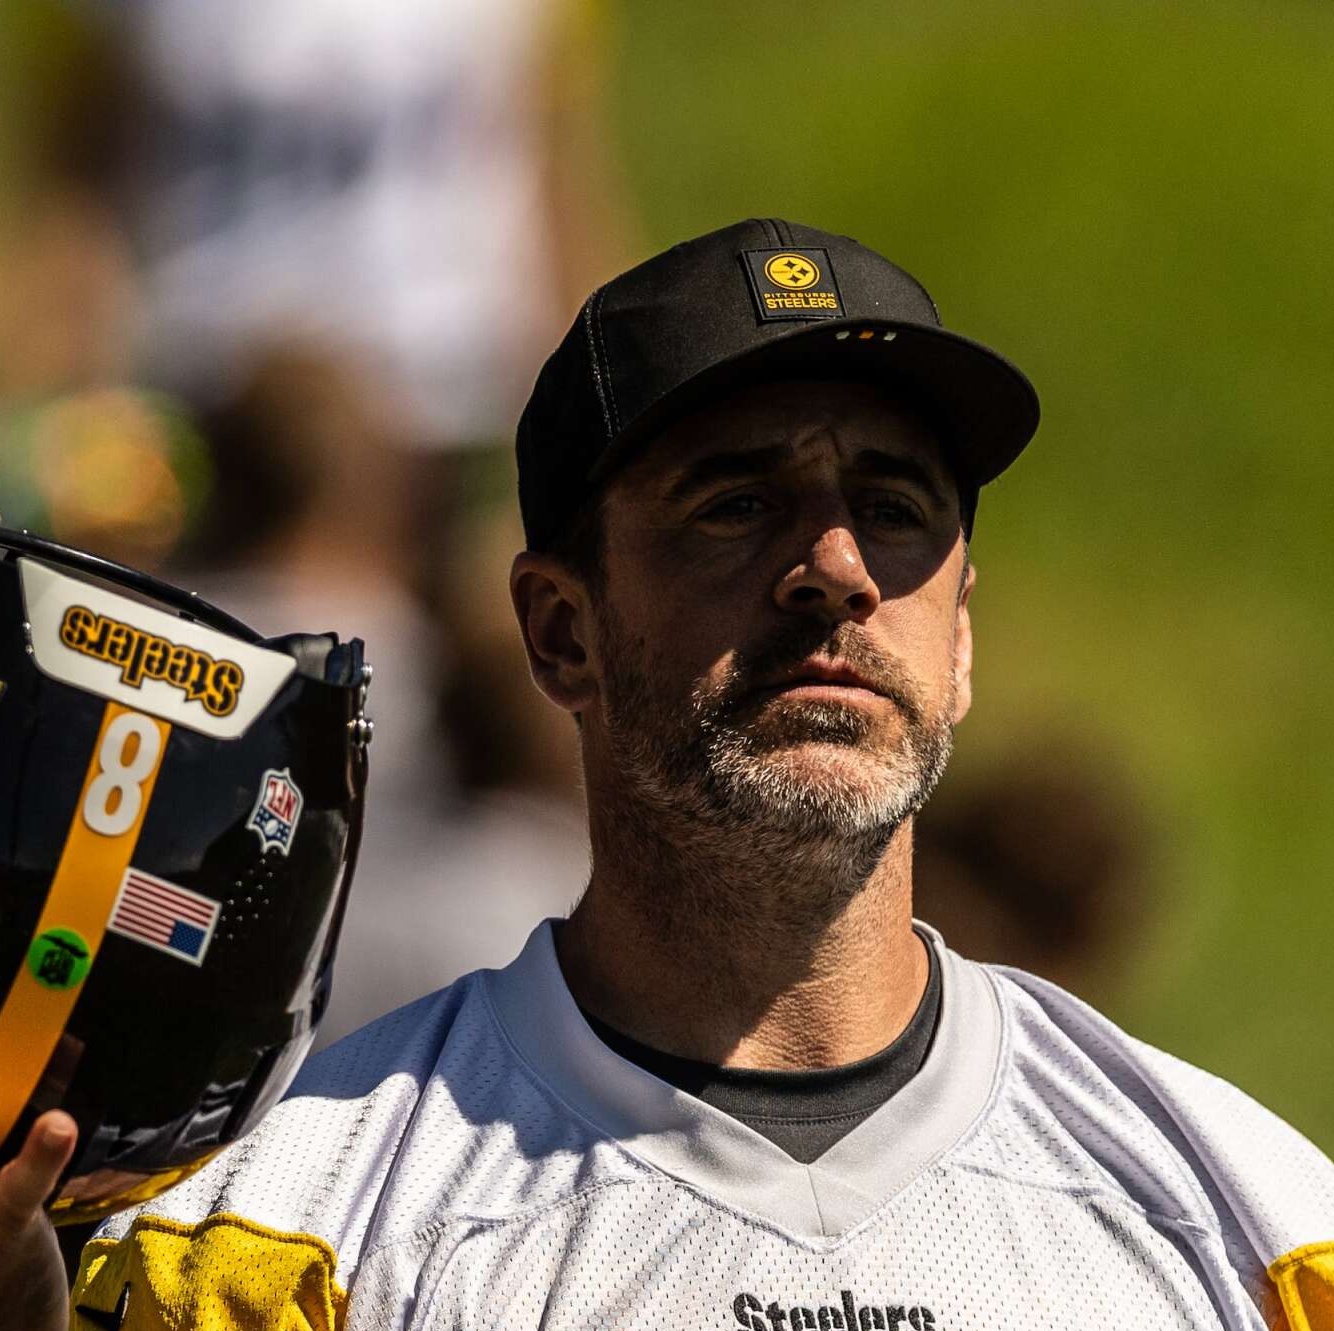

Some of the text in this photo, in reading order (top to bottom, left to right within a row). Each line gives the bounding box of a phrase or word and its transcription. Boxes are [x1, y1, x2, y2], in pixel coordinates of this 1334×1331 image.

[765, 298, 838, 309] STEELERS
[60, 605, 244, 717] Steelers
[82, 711, 162, 837] 8
[267, 780, 297, 825] NFL
